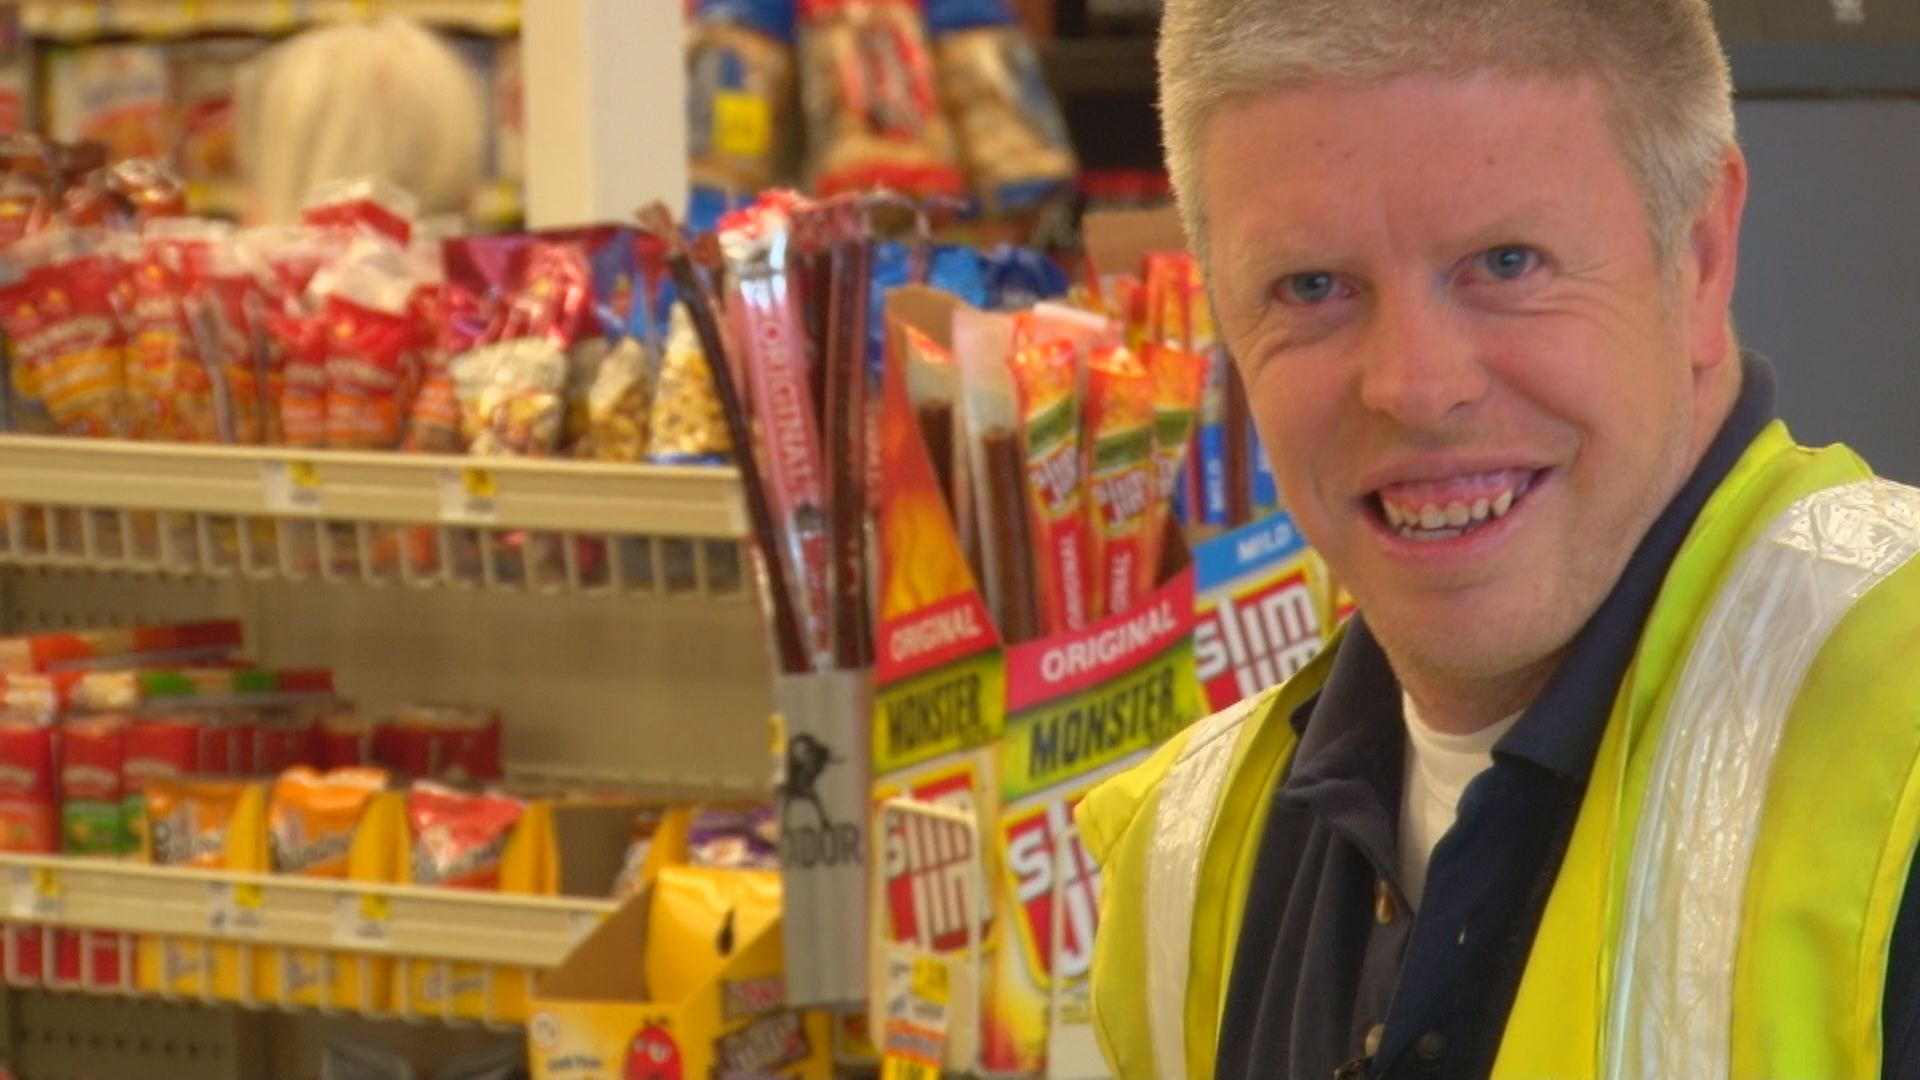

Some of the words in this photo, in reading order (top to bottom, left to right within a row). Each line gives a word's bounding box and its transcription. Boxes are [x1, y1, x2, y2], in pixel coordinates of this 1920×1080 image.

[1237, 521, 1292, 563] MILD
[890, 603, 983, 663] ORIGINAL
[1041, 601, 1177, 683] ORIGINAL
[888, 673, 980, 759] MONSTER
[1029, 666, 1174, 782] MONSTER
